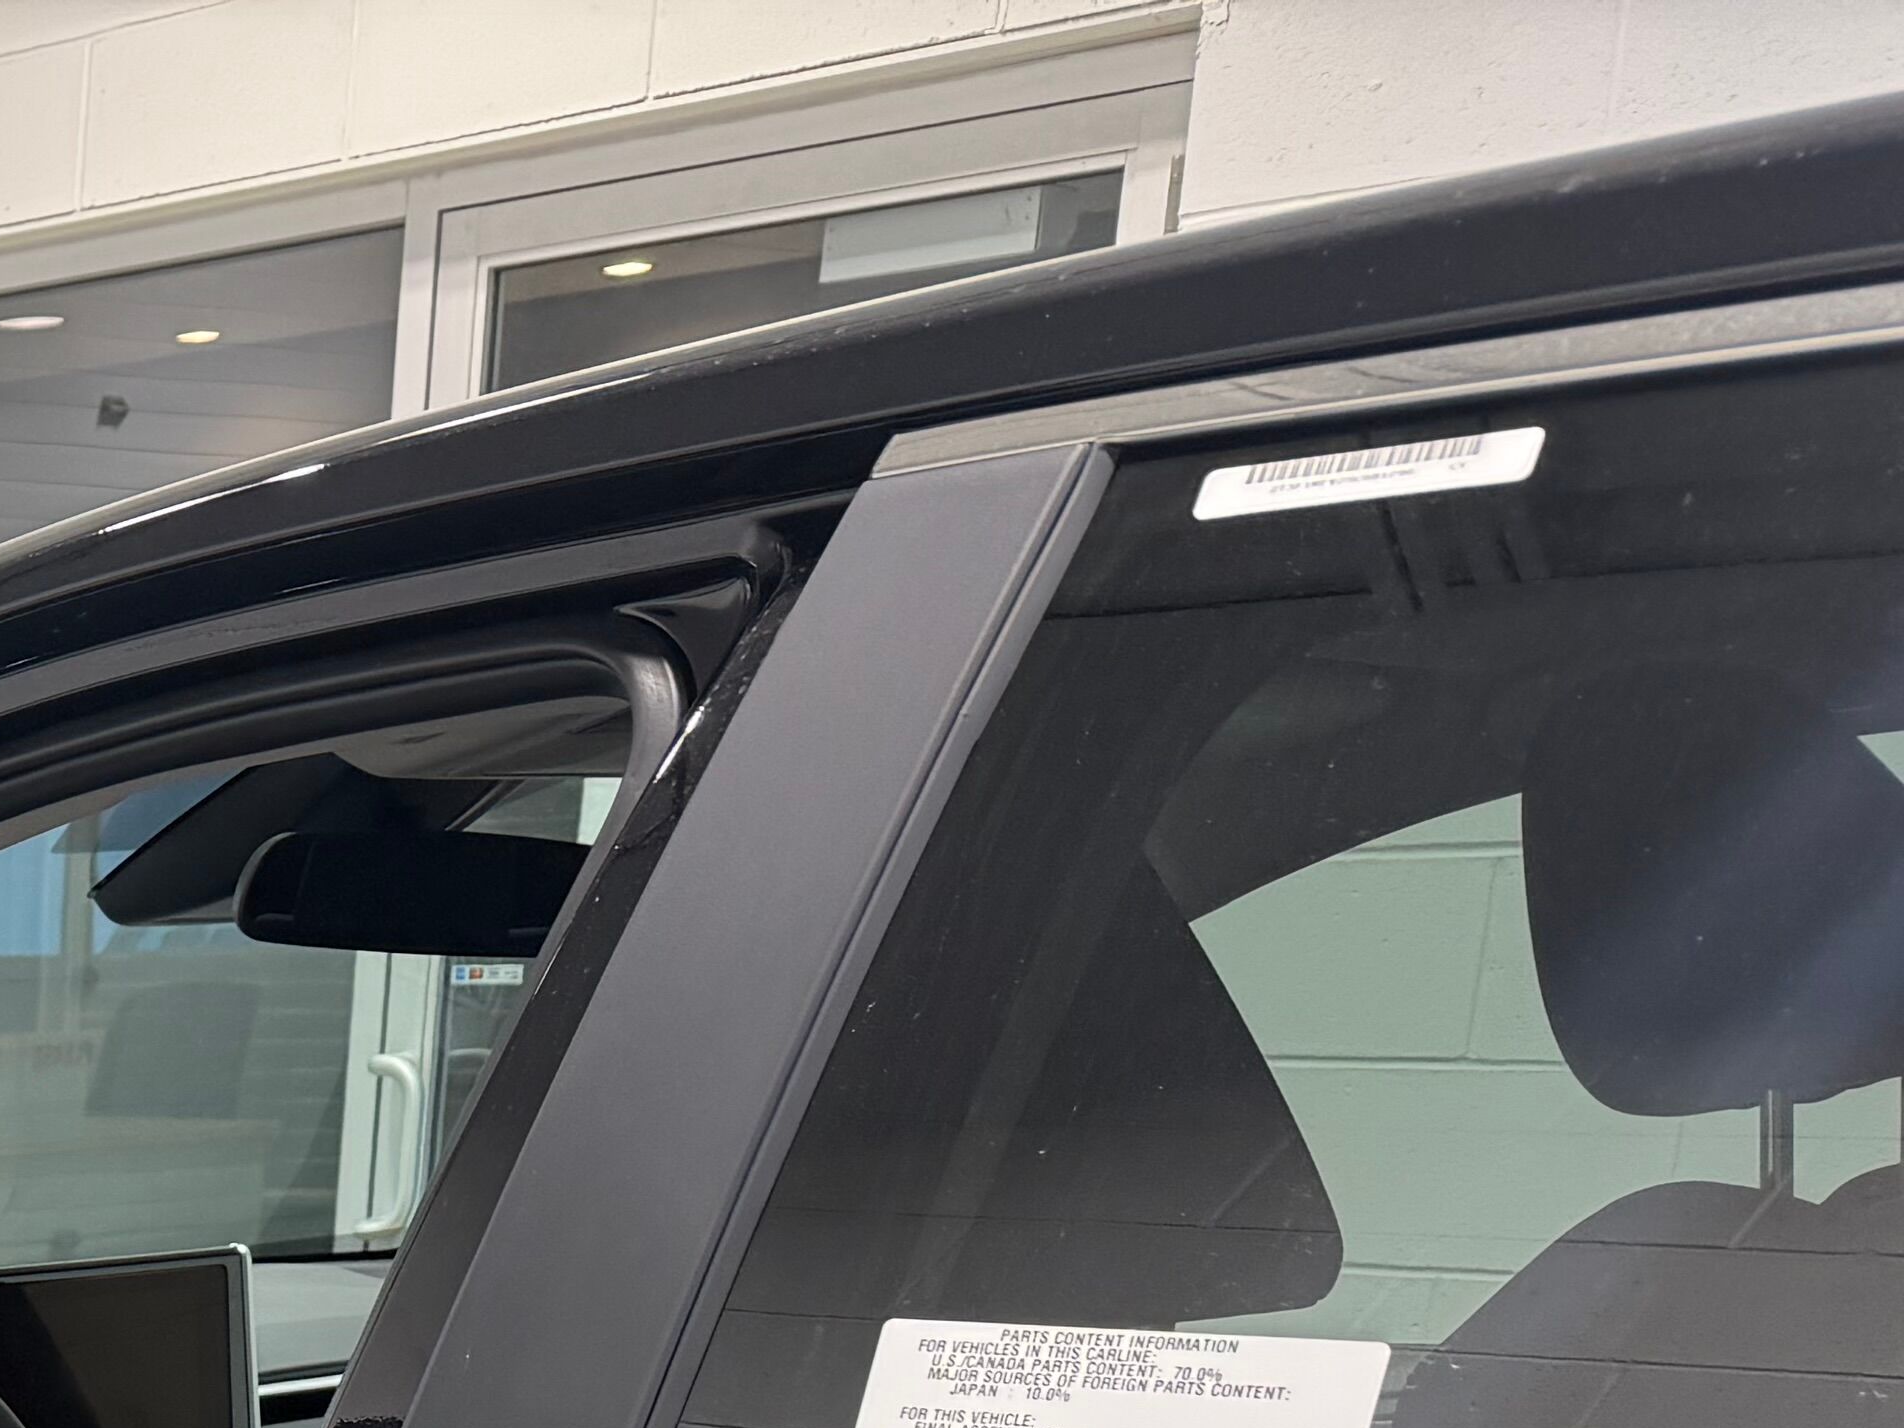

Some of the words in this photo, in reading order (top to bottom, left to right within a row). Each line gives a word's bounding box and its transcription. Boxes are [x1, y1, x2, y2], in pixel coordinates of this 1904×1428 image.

[918, 1339, 946, 1352] FOR
[952, 1341, 1020, 1356] VEHICLES
[1025, 1345, 1041, 1357] IN
[1048, 1346, 1079, 1359] THIS
[1086, 1347, 1157, 1363] CARLINE:
[1000, 1329, 1050, 1344] PARTS
[1054, 1331, 1124, 1348] CONTENT
[1130, 1335, 1239, 1353] INFORMATION
[931, 1354, 1025, 1371] U.S./CANADA
[1031, 1359, 1080, 1374] PARTS
[1086, 1362, 1162, 1378] CONTENT:
[1174, 1367, 1223, 1382] 70.0%
[927, 1368, 978, 1382] MAJOR
[983, 1370, 1052, 1386] SOURCES
[1057, 1374, 1076, 1388] OF
[1082, 1377, 1148, 1392] FOREIGN
[1153, 1380, 1205, 1396] PARTS
[1211, 1383, 1292, 1401] CONTENT:
[949, 1383, 998, 1397] JAPAN
[1026, 1388, 1070, 1402] 10.0%
[900, 1407, 928, 1420] FOR
[934, 1409, 966, 1423] THIS
[971, 1411, 1036, 1428] VEHICLE:
